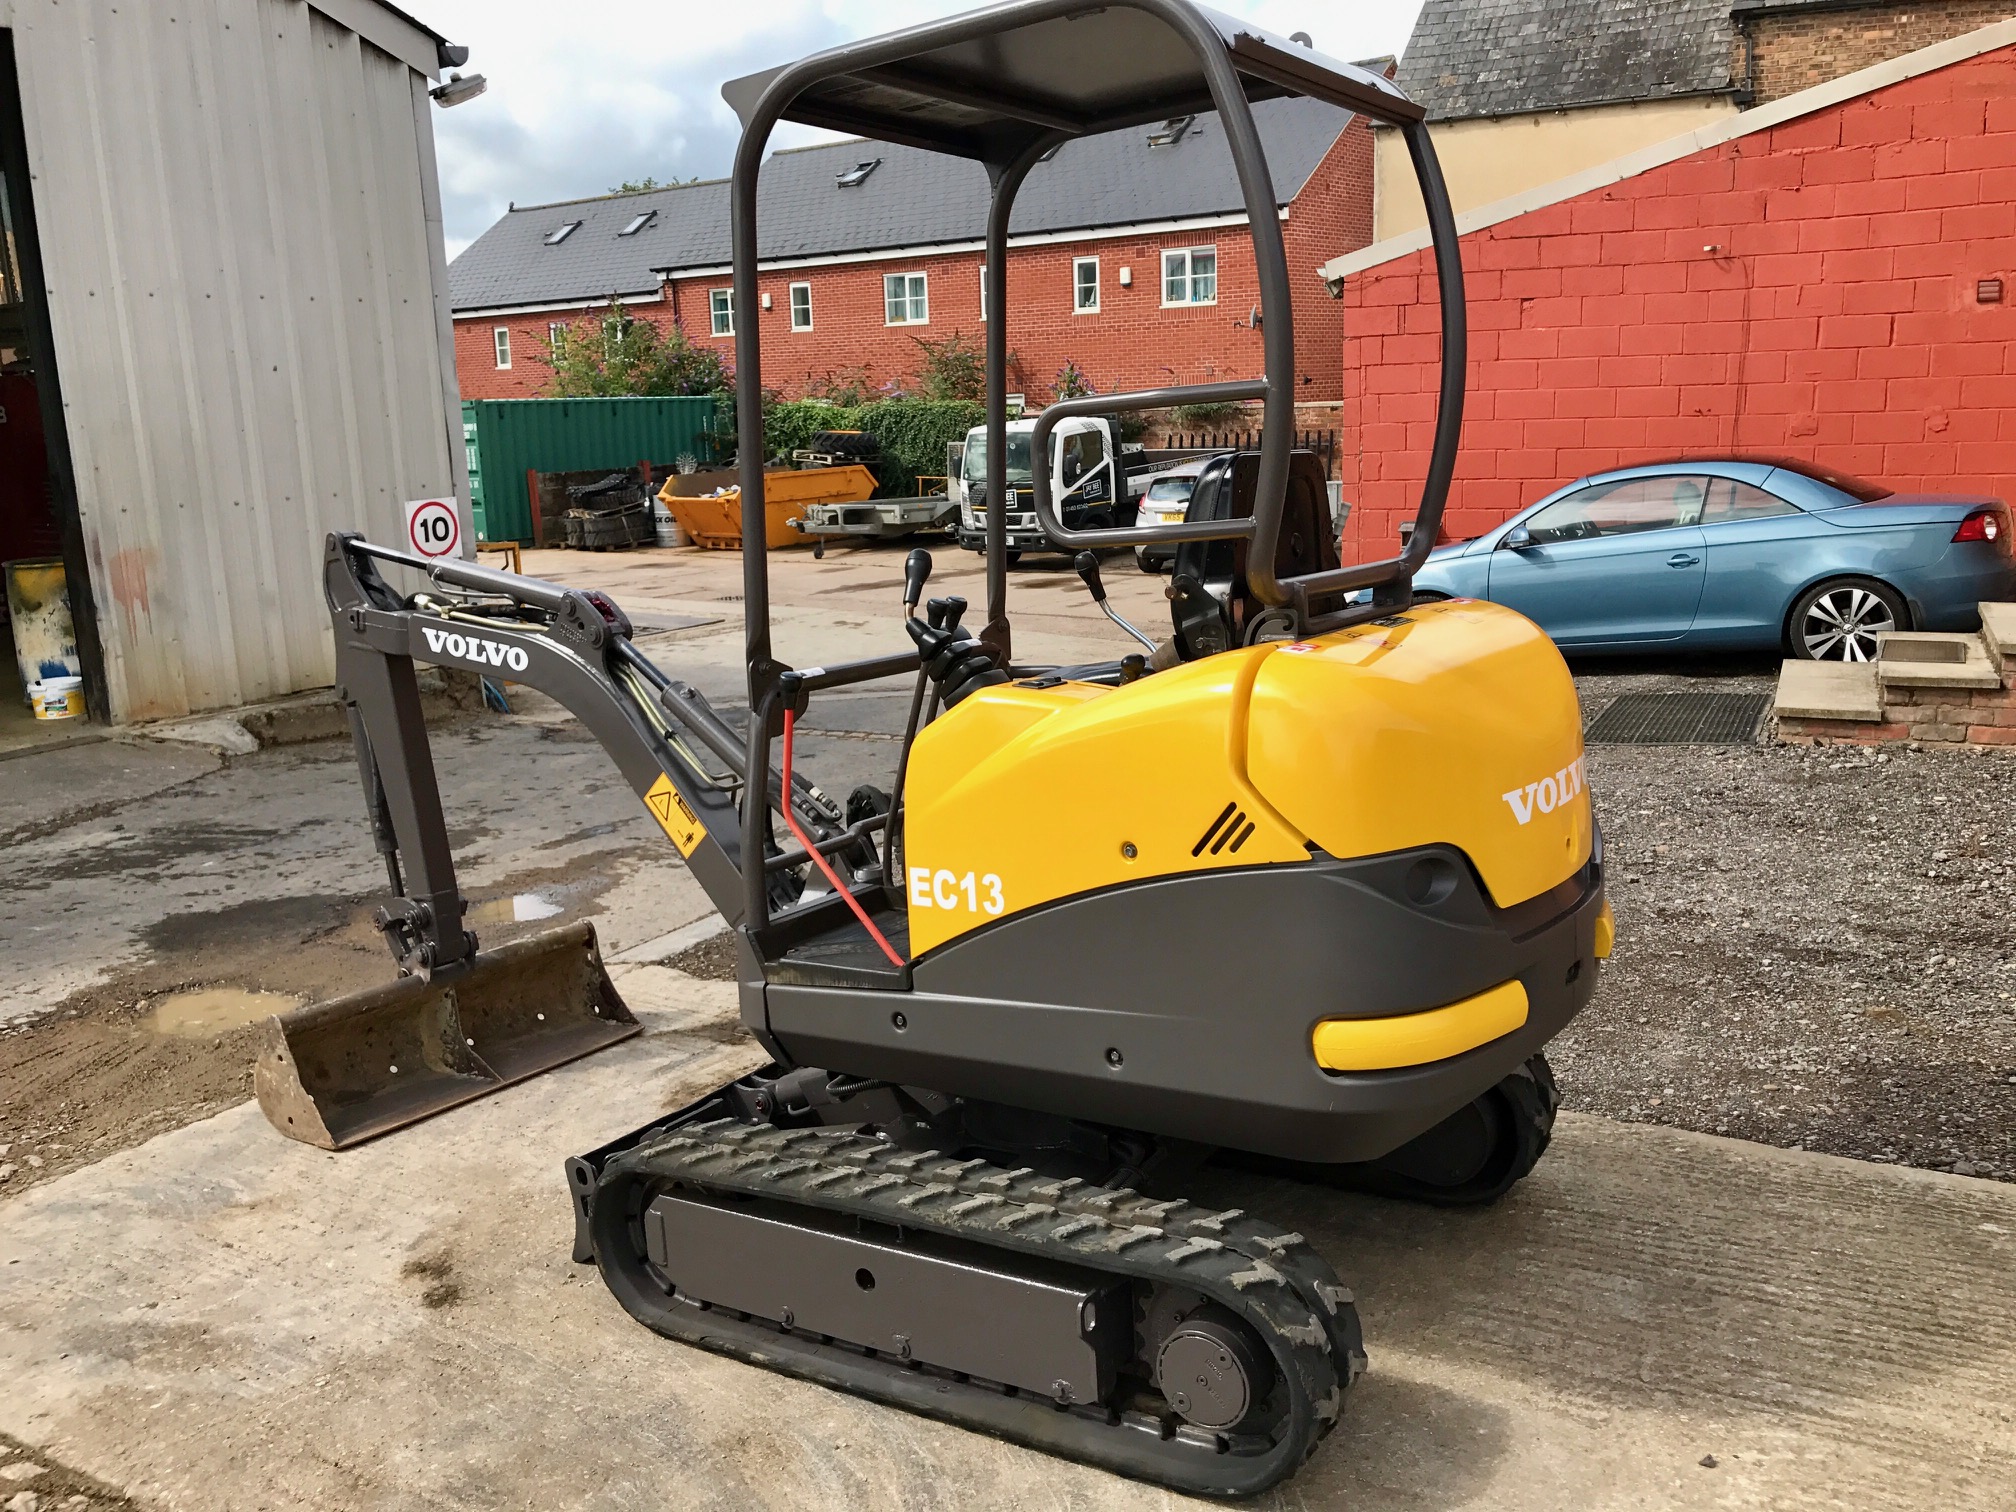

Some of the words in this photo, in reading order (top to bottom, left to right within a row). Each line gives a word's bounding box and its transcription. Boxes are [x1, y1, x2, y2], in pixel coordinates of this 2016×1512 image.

[420, 516, 449, 543] 10
[422, 627, 529, 672] VOLVO
[909, 866, 1005, 915] EC13
